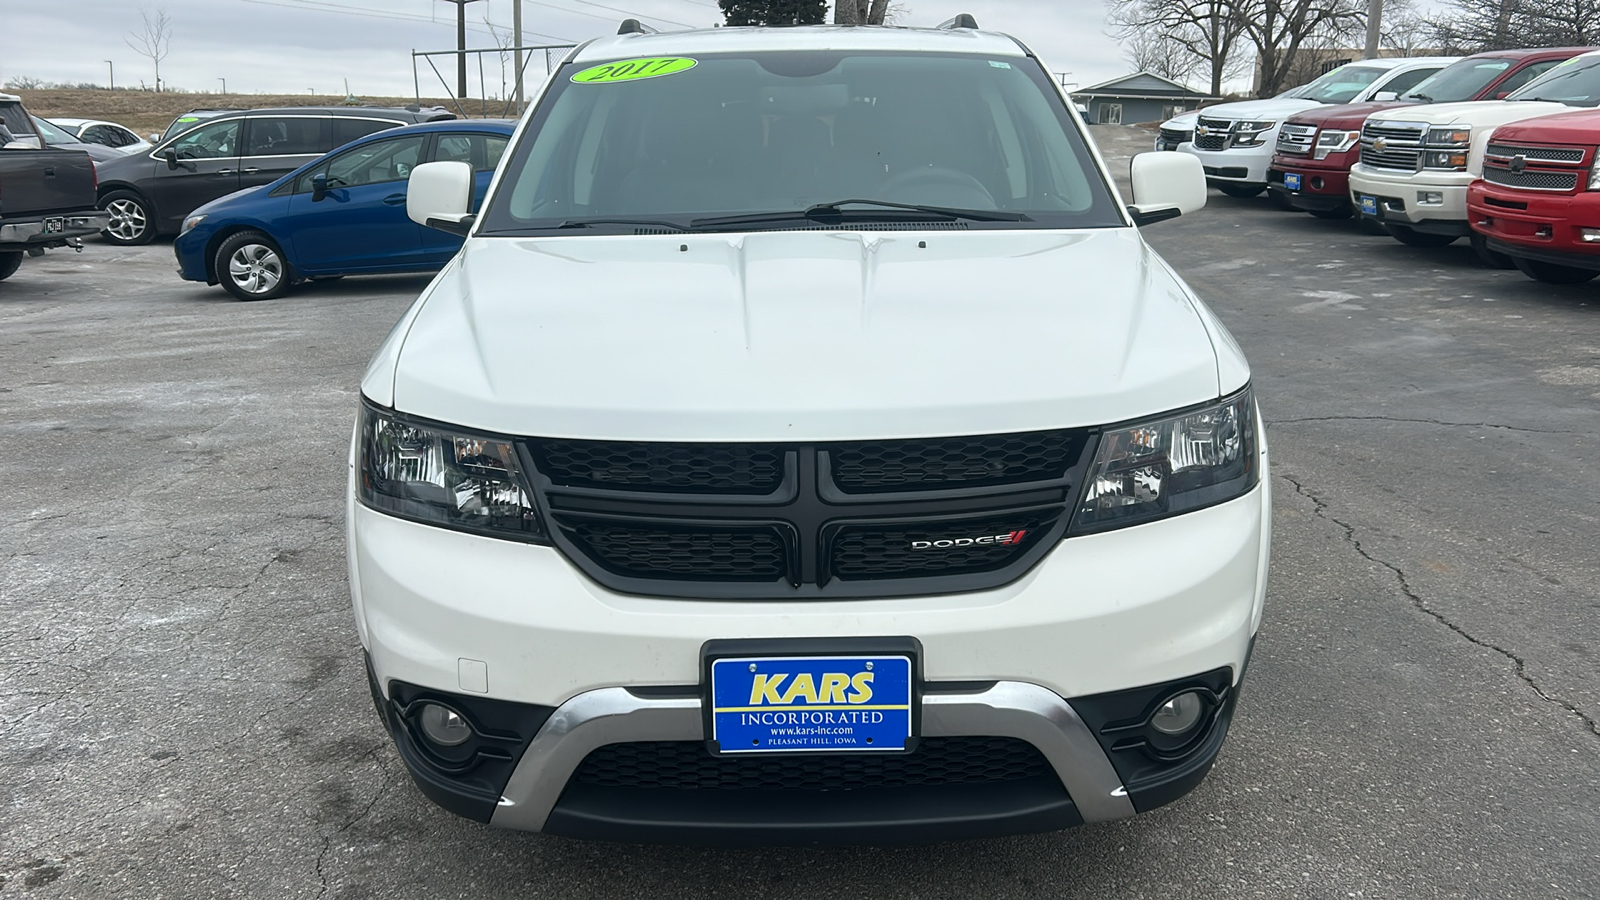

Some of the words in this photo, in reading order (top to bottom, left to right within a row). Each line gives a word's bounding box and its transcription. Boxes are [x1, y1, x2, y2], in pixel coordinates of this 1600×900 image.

[587, 58, 679, 81] 2017
[912, 533, 1013, 549] DODGE
[749, 672, 875, 705] KARS
[741, 711, 884, 725] INCORPORATED
[770, 726, 853, 737] www.kars-inc.com
